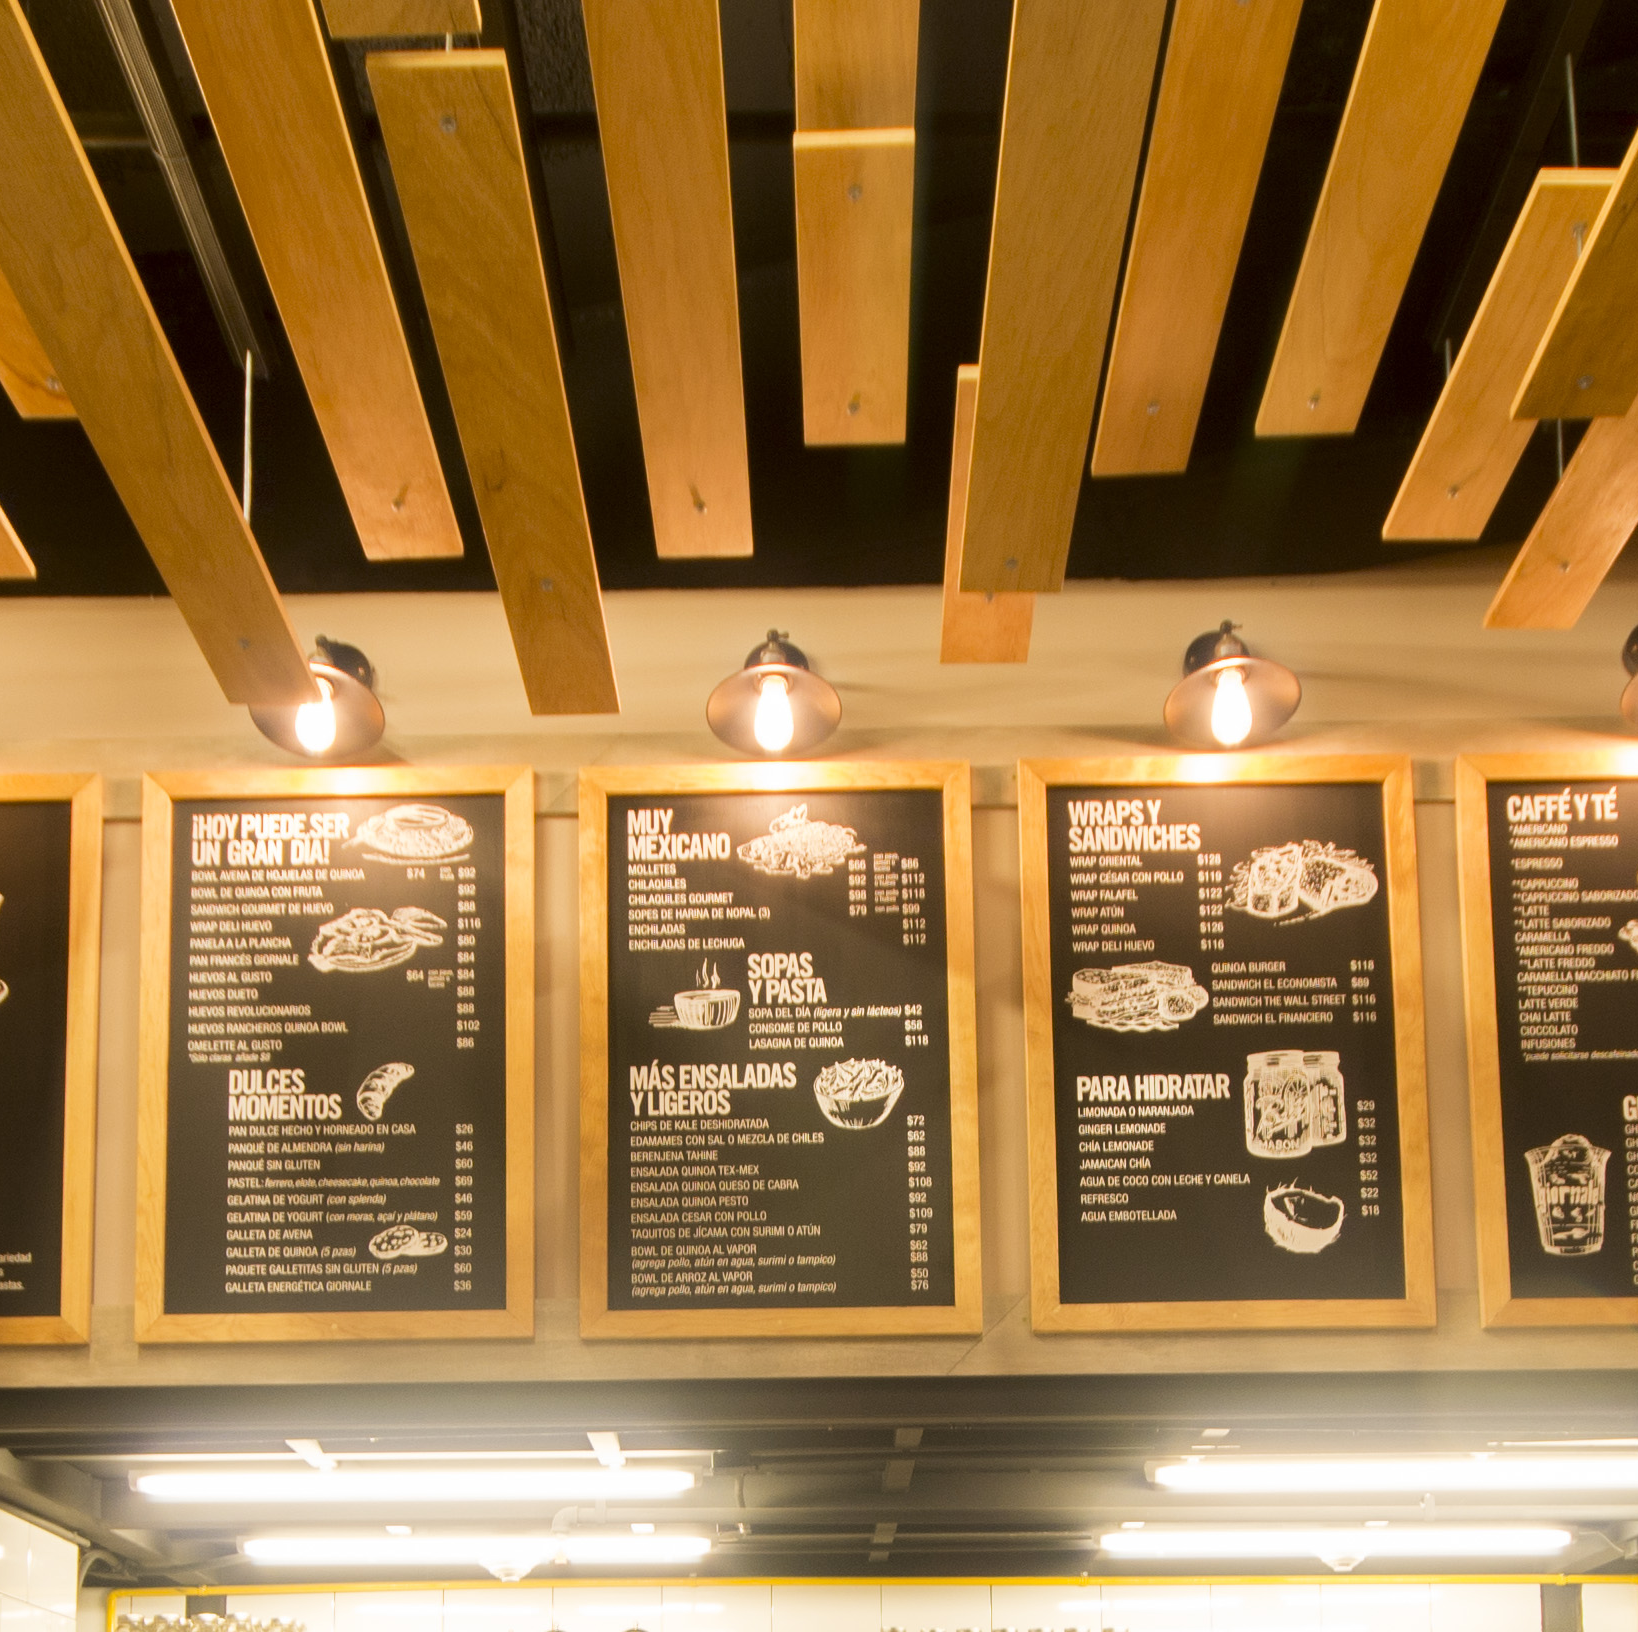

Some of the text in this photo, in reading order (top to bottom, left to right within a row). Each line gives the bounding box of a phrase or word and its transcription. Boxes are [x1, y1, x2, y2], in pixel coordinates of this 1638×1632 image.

[1068, 799, 1162, 826] WRAPS Y
[1507, 786, 1618, 821] CAFFÉ Y TÉ
[241, 813, 307, 841] PUEDE
[308, 812, 348, 838] SER
[627, 808, 673, 835] MUY
[627, 833, 730, 861] MEXICANO
[1069, 824, 1201, 852] SANDWICHES
[192, 838, 329, 866] UN GRAN DÍA!
[748, 952, 813, 979] SOPAS
[748, 977, 827, 1004] Y PASTA
[229, 1069, 304, 1095] DULCES
[630, 1059, 796, 1090] MÁS ENSALADAS
[1077, 1074, 1230, 1101] PARA HIDRATAR
[229, 1094, 341, 1121] MOMENTOS
[630, 1089, 730, 1116] Y LIGEROS
[1078, 1106, 1127, 1118] LIMONADA
[1129, 1106, 1135, 1117] O
[1138, 1104, 1194, 1117] NARANJADA
[229, 1123, 473, 1136] PAN DULCE HECHO Y HORNEADO EN CASA $26
[630, 1115, 924, 1132] CHIPS DE KALE DESHIDRATADA $72
[631, 1212, 679, 1224] ENSALADA
[715, 1211, 735, 1222] CON
[737, 1210, 767, 1222] POLLO
[910, 1207, 932, 1219] $109
